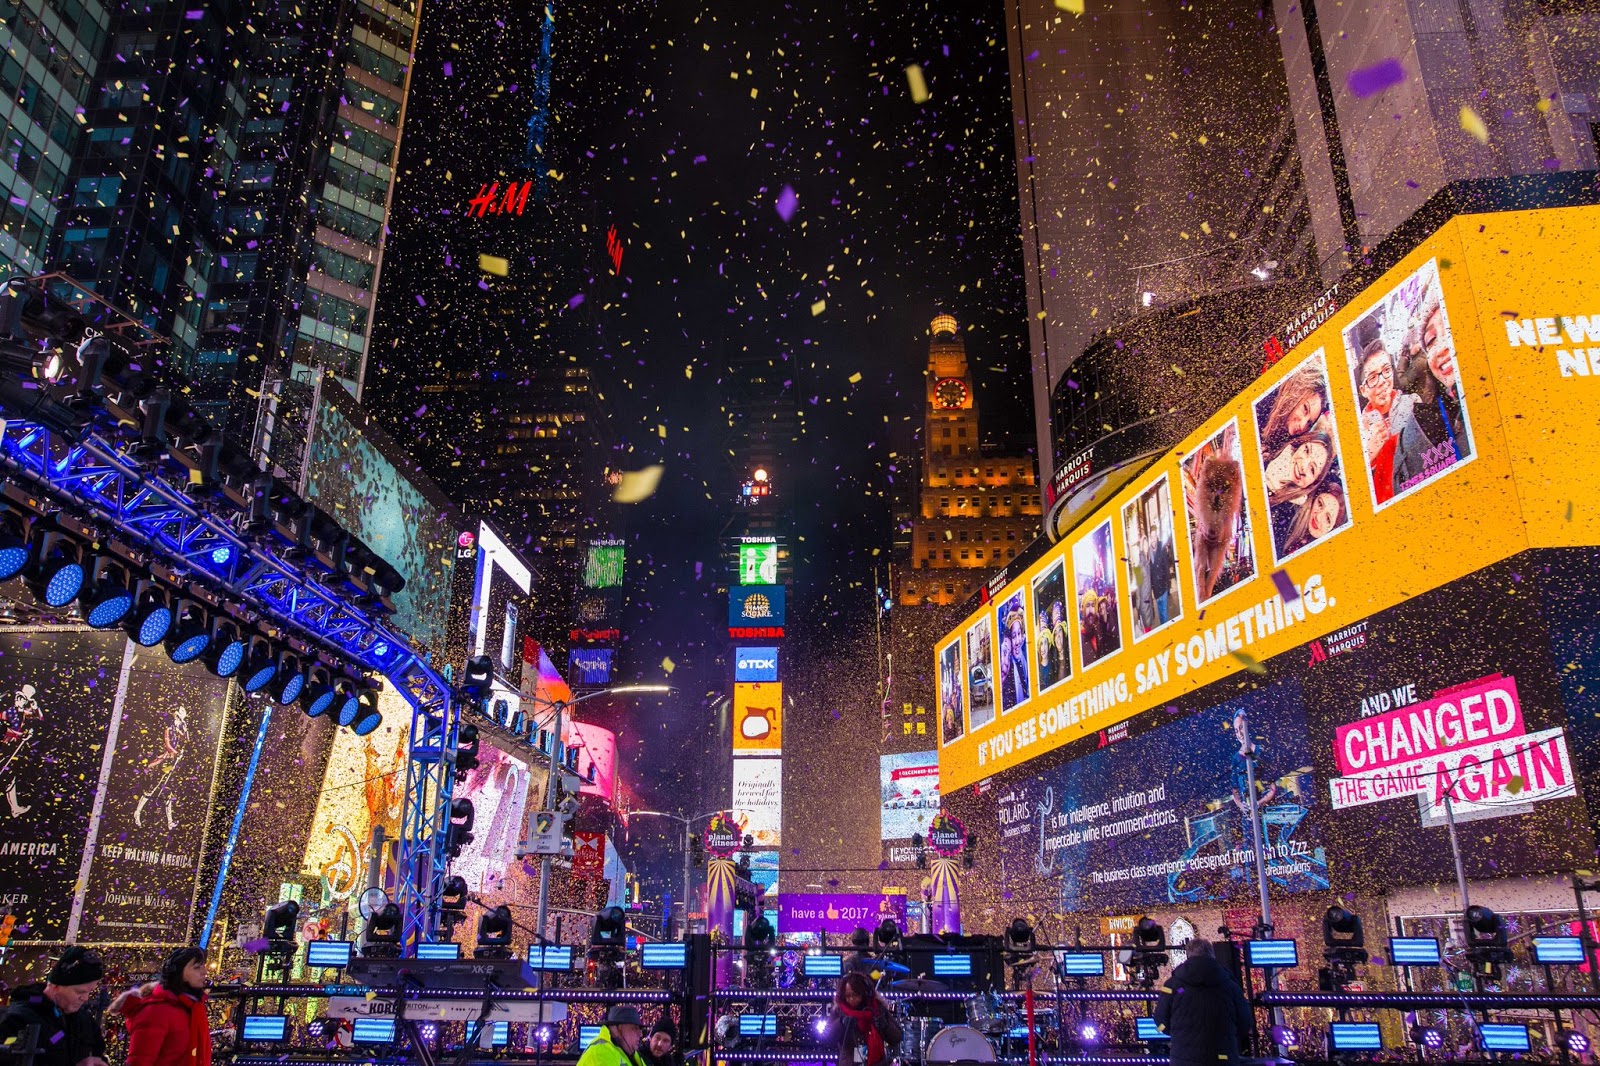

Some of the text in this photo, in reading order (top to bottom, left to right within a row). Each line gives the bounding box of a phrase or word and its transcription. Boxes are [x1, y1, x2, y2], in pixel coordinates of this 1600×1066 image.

[467, 180, 532, 218] H&M
[1287, 283, 1339, 334] MARRIOTT
[1289, 303, 1335, 348] MARQUIS
[1504, 314, 1600, 347] NEW
[1055, 448, 1094, 483] MARRIOTT
[1057, 464, 1089, 495] MARQUIS
[457, 549, 472, 558] LG
[728, 627, 784, 638] TOSHIBA
[1327, 621, 1368, 645] MARRIOTT
[1329, 635, 1365, 656] MARQUIS
[747, 659, 775, 669] TDK
[977, 573, 1337, 767] IF YOU SEE SOMETHING, SAY SOMETHING.
[1360, 683, 1418, 719] AND WE
[1344, 688, 1517, 769] CHANGED
[1334, 737, 1567, 807] THE GAME AGAIN
[738, 780, 775, 789] Originally
[1051, 782, 1166, 829] is for intelligence, intuition and
[708, 833, 734, 842] planet
[931, 831, 958, 840] planet
[1045, 808, 1179, 851] impeccable wine recommendations.
[0, 842, 57, 856] AMERICA
[934, 838, 964, 846] fitness
[101, 844, 193, 868] KEEP WALKING AMERICA
[1092, 870, 1103, 883] The
[1103, 866, 1129, 883] business
[1130, 864, 1147, 879] class
[1147, 860, 1186, 878] experience
[1231, 849, 1255, 863] from
[1277, 842, 1288, 858] to
[791, 907, 869, 919] have a 2017
[129, 973, 150, 981] SONY
[471, 965, 494, 974] XK-2
